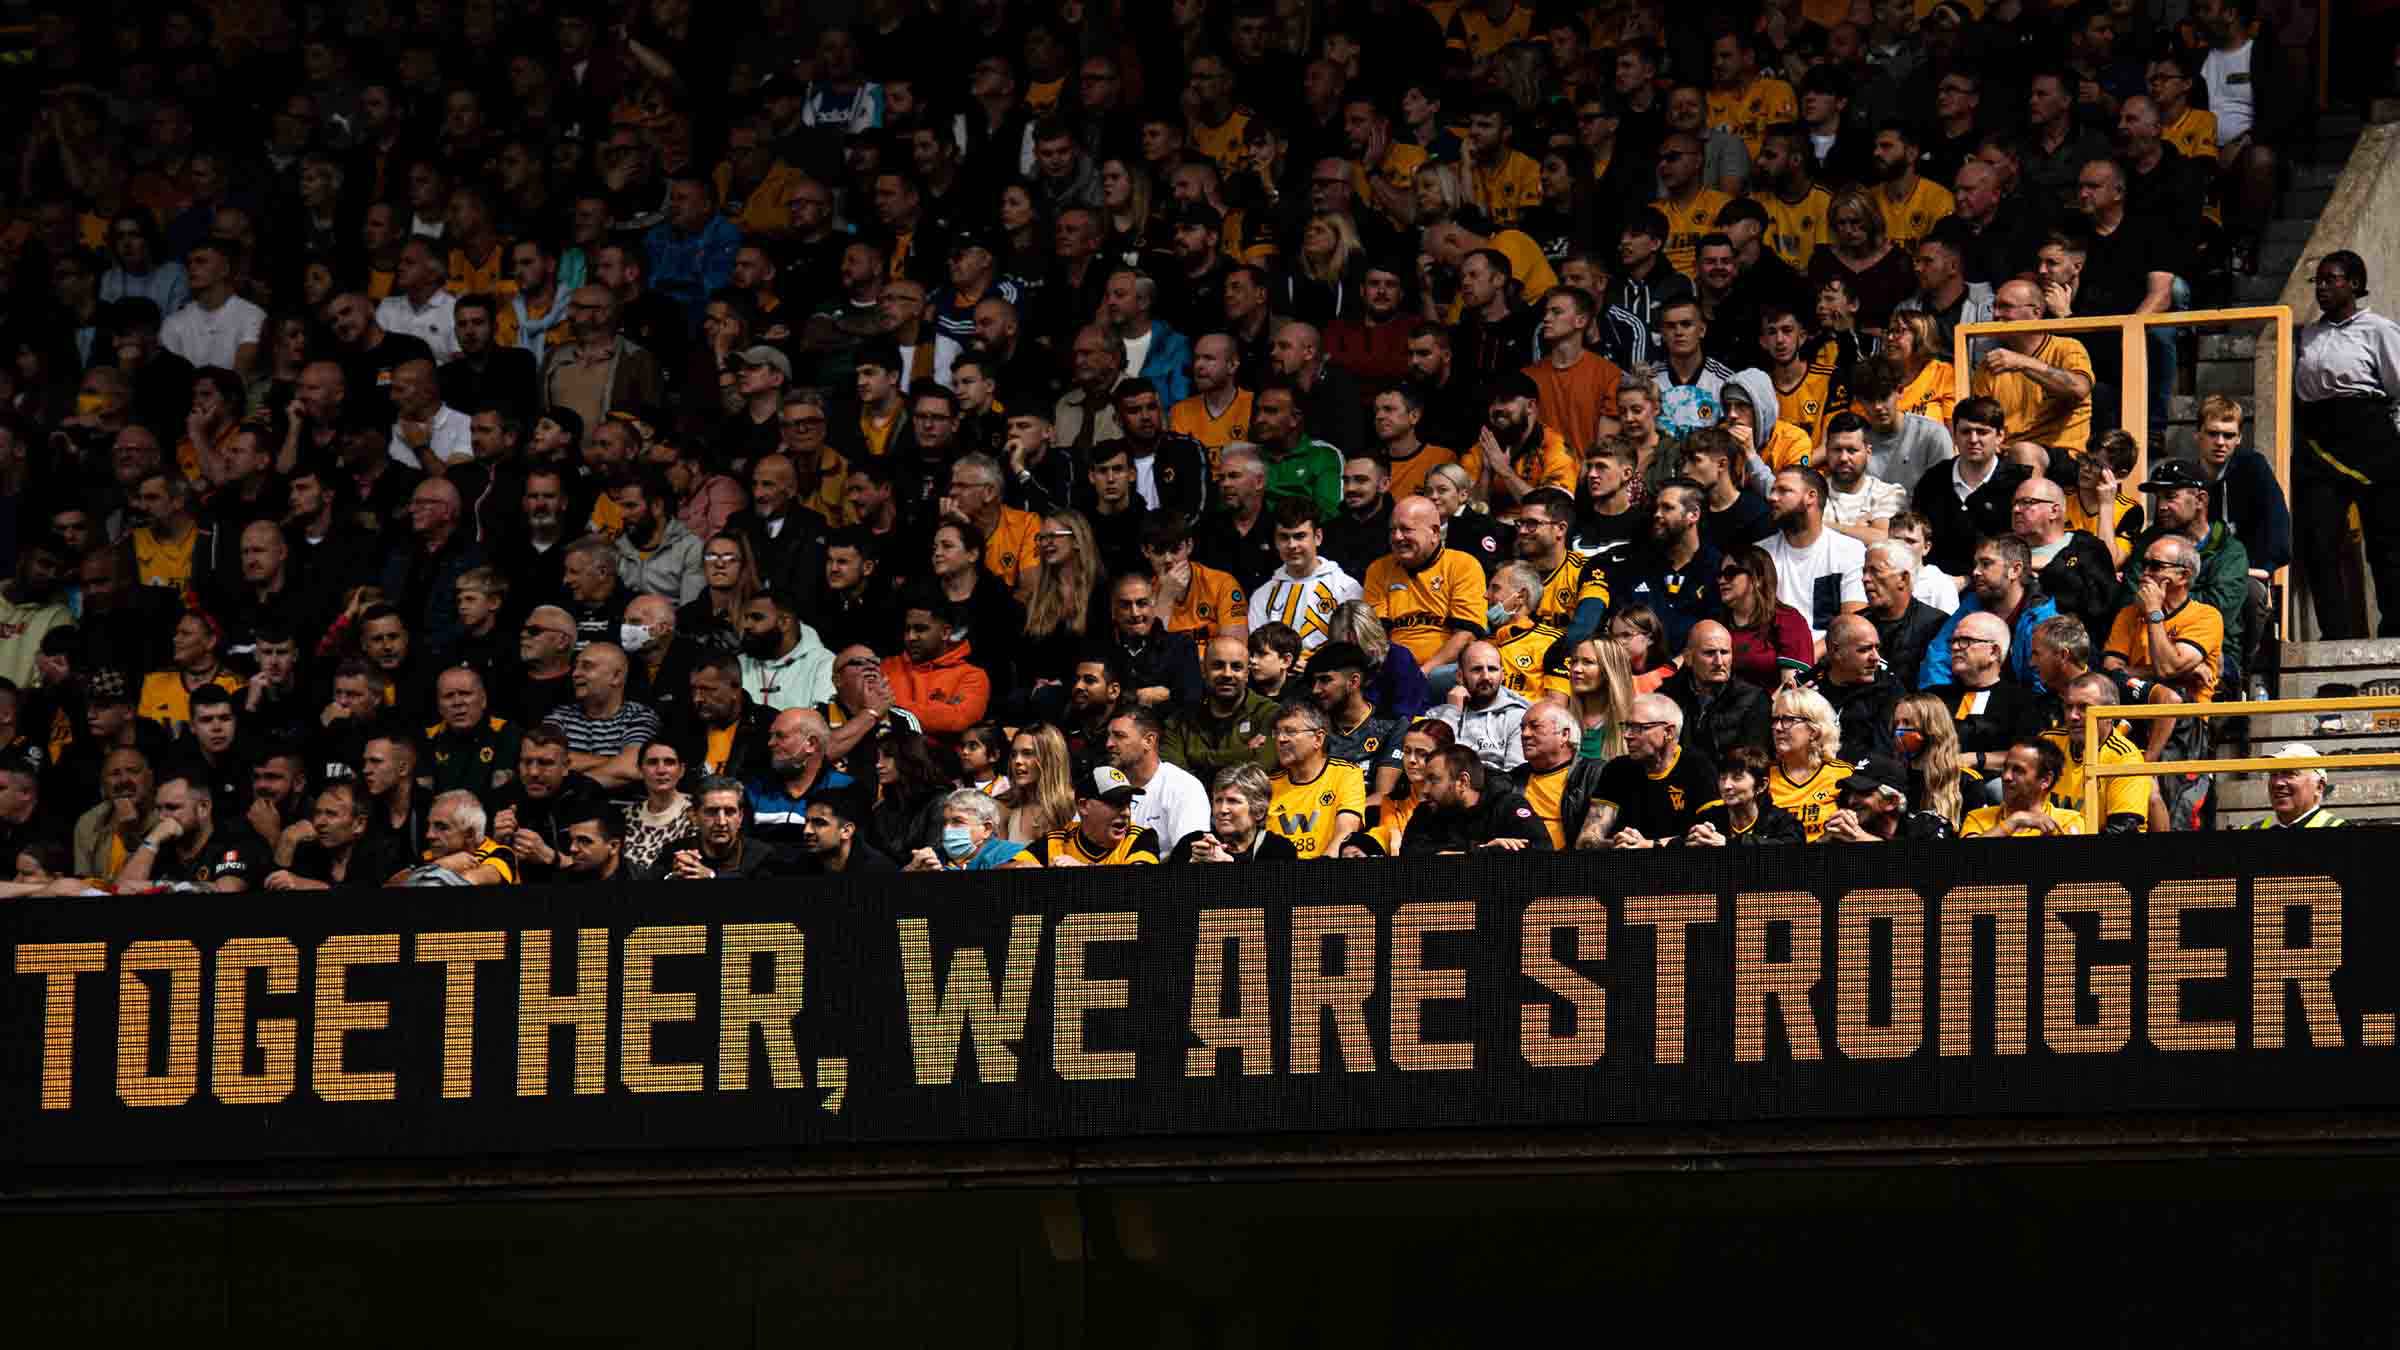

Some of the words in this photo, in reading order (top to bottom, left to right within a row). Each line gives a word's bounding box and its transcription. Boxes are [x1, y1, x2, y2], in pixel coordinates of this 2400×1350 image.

[1279, 810, 1321, 835] W
[1291, 837, 1317, 852] 88
[14, 921, 849, 1115] TOGETHER,
[896, 911, 1140, 1086] WE
[1184, 900, 1477, 1078] ARE
[1519, 874, 2397, 1068] STRONGER.
